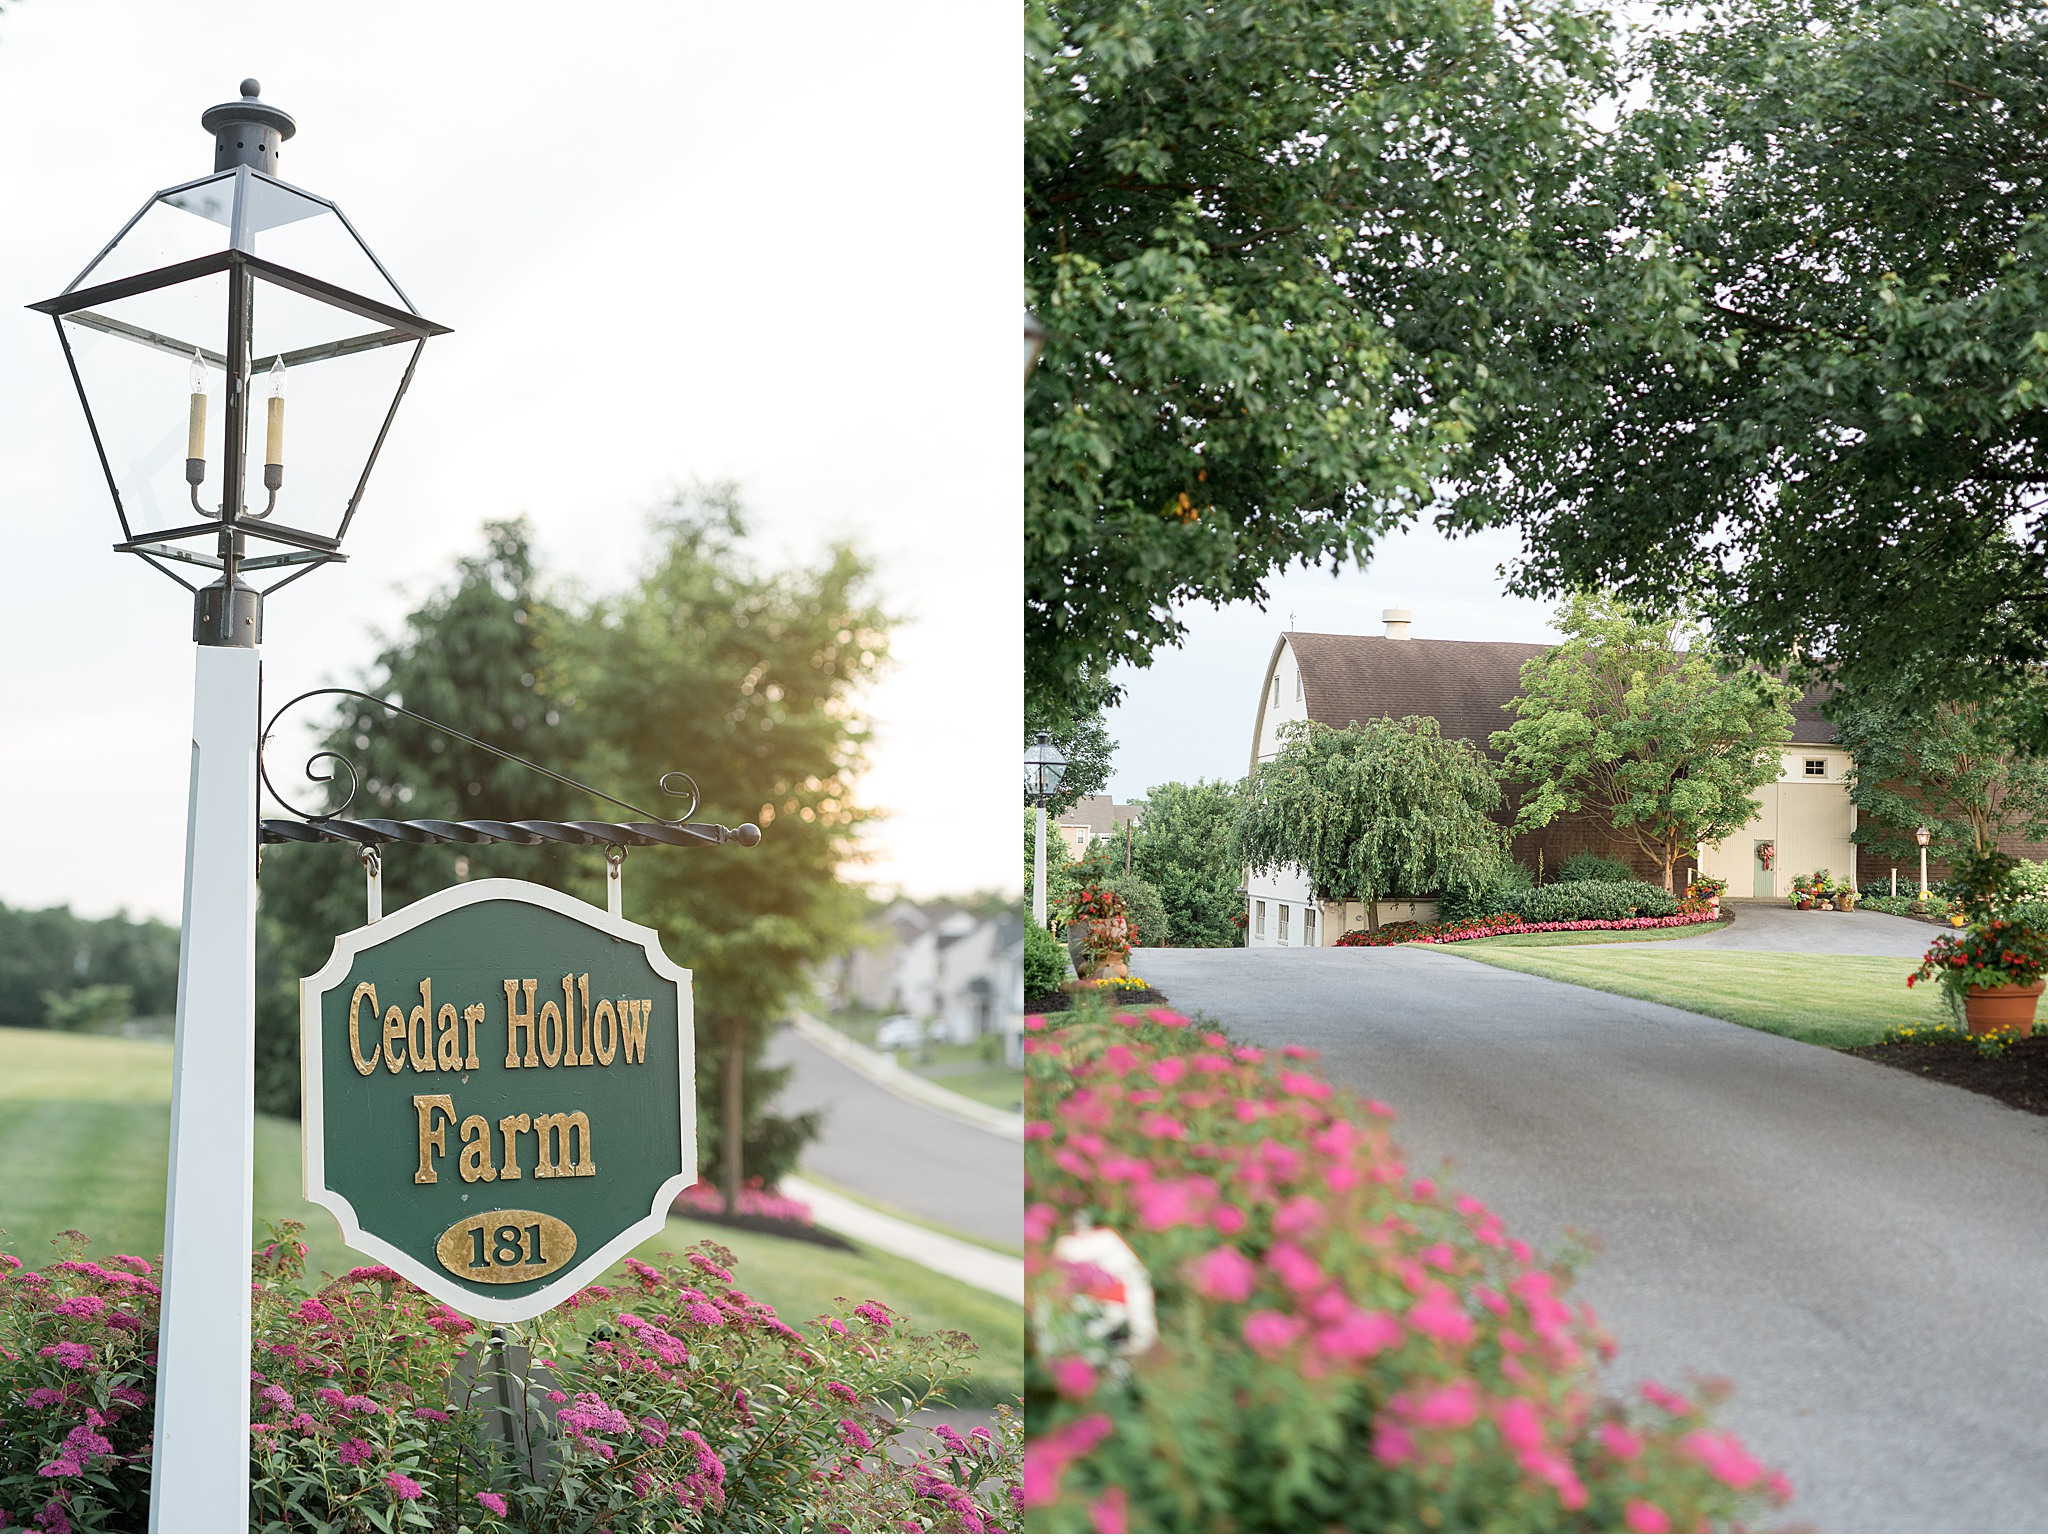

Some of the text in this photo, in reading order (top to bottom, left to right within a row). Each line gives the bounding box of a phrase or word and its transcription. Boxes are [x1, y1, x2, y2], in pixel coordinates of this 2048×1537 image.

[349, 972, 653, 1076] Cedar Hollow
[412, 1093, 596, 1185] Farm
[467, 1224, 548, 1269] 181
